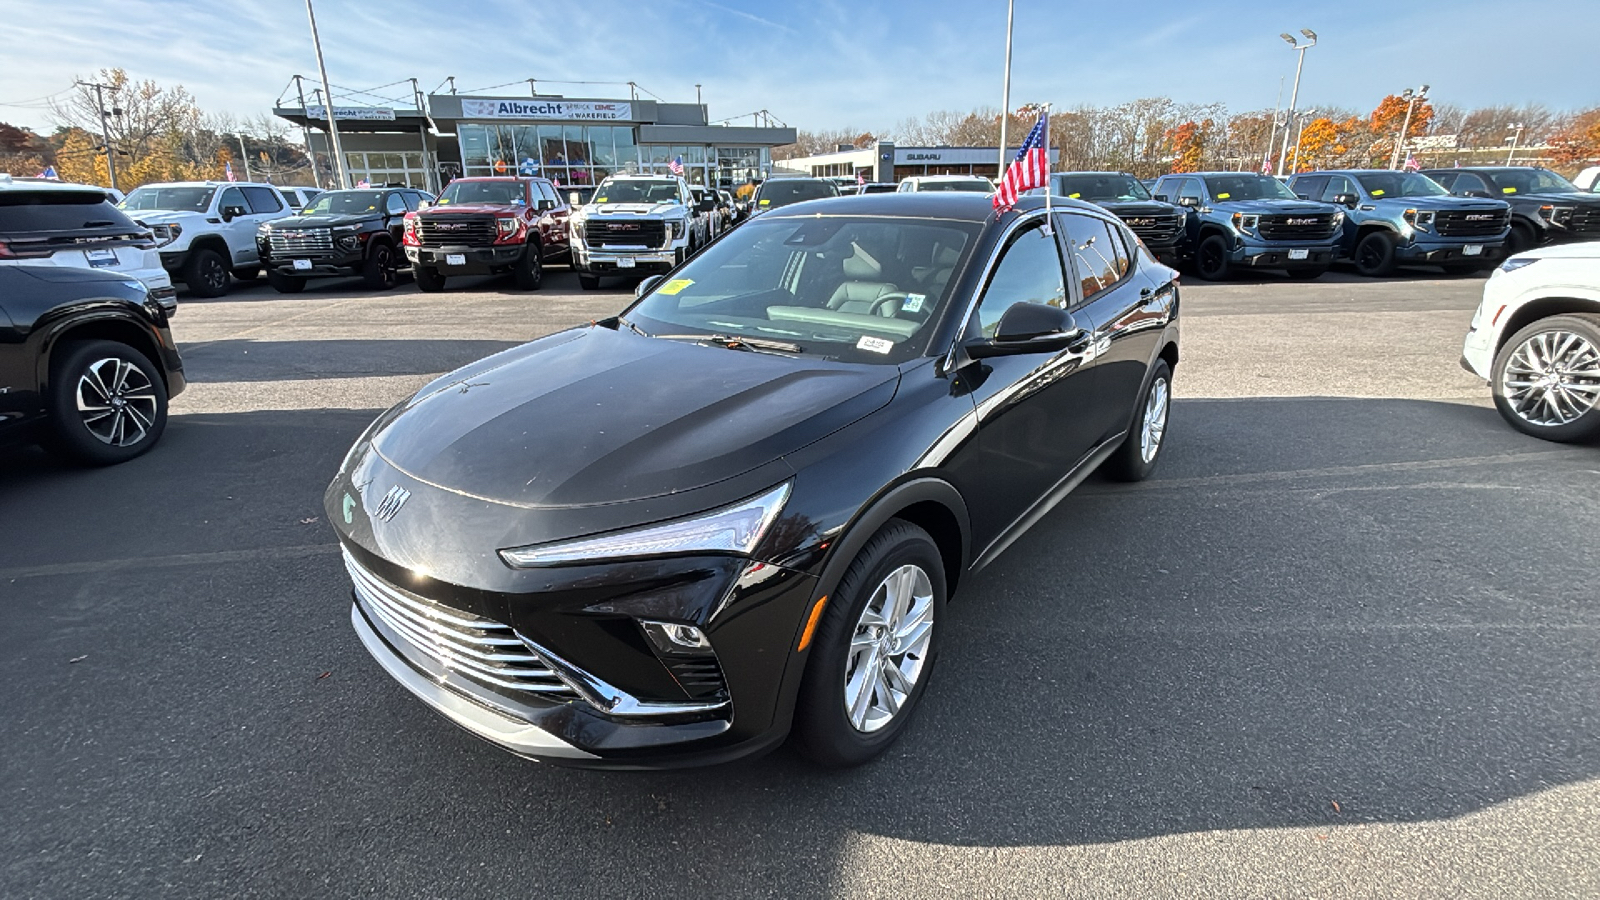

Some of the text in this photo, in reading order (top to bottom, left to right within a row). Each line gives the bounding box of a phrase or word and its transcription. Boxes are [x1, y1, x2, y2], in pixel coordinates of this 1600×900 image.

[498, 102, 563, 115] Albrecht
[906, 153, 941, 161] SUBARU
[1287, 218, 1318, 226] GMC
[436, 223, 468, 231] GMC
[608, 223, 639, 231] GMC
